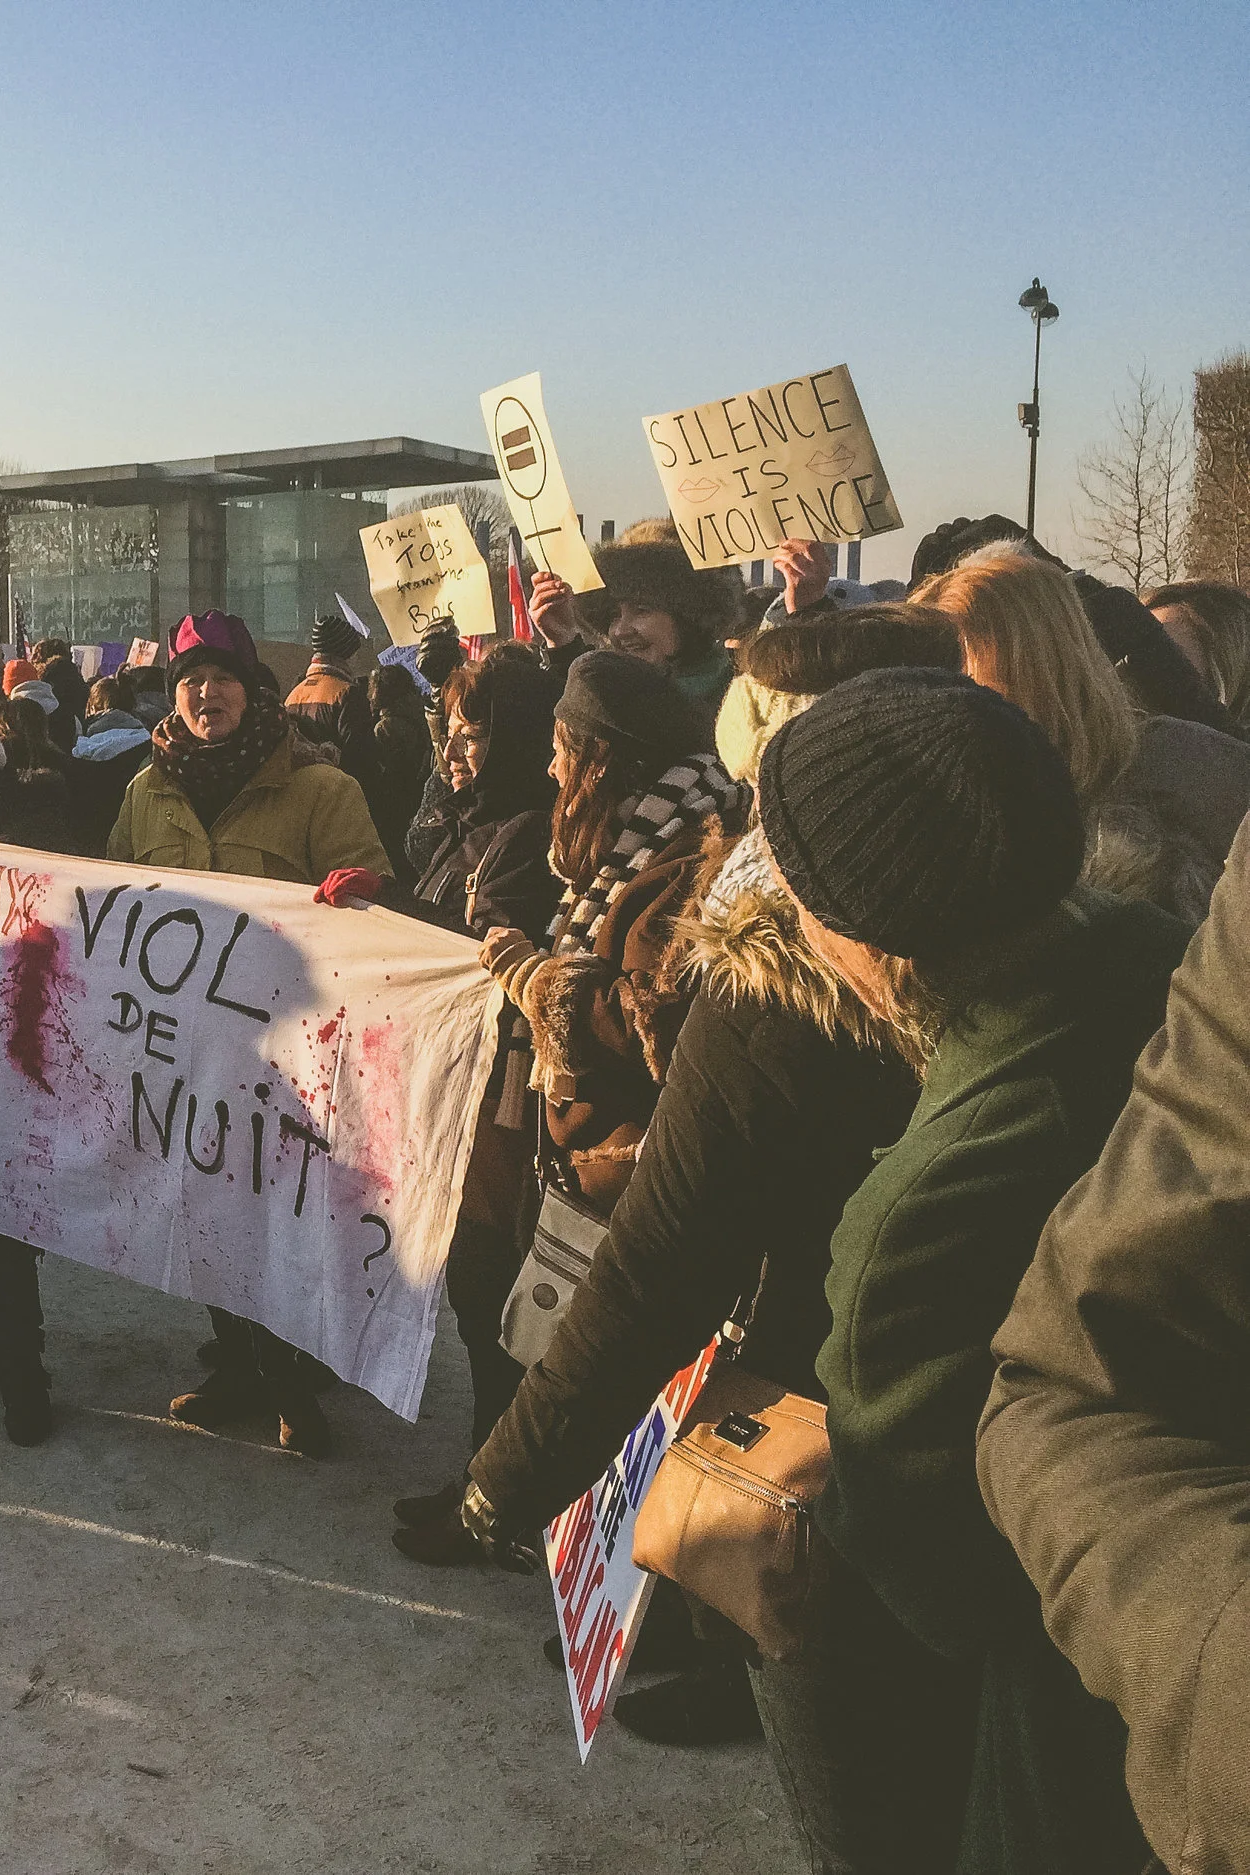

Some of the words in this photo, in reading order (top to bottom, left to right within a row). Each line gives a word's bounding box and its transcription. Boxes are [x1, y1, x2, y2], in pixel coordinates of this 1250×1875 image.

[650, 370, 851, 468] SILENCE
[679, 474, 894, 561] VIOLENCE
[733, 459, 789, 498] IS
[373, 529, 417, 550] Take
[107, 991, 179, 1065] DE
[360, 1213, 392, 1299] ?
[595, 1462, 628, 1564] THE
